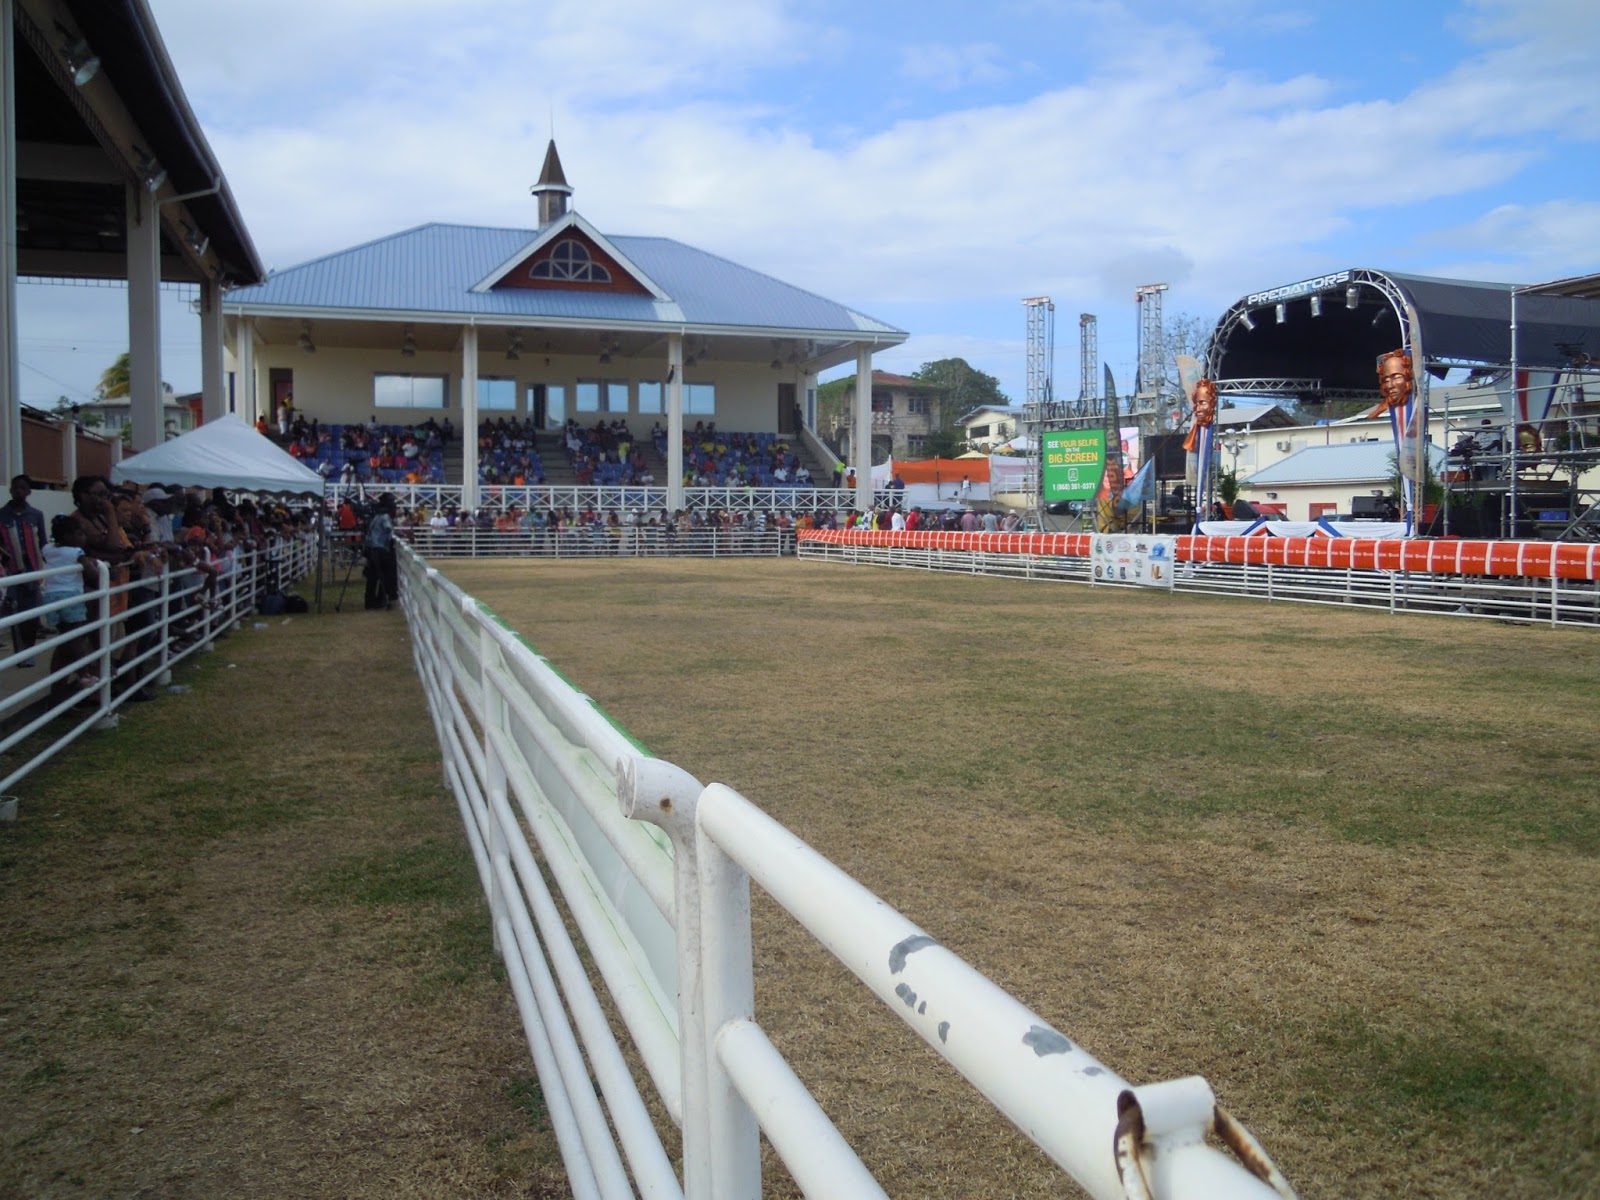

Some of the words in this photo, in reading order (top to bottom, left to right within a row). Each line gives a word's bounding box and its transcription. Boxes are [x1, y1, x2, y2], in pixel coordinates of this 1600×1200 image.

[1248, 271, 1350, 305] PREDATORS
[1048, 453, 1063, 464] BIG
[1065, 452, 1098, 463] SCREEN
